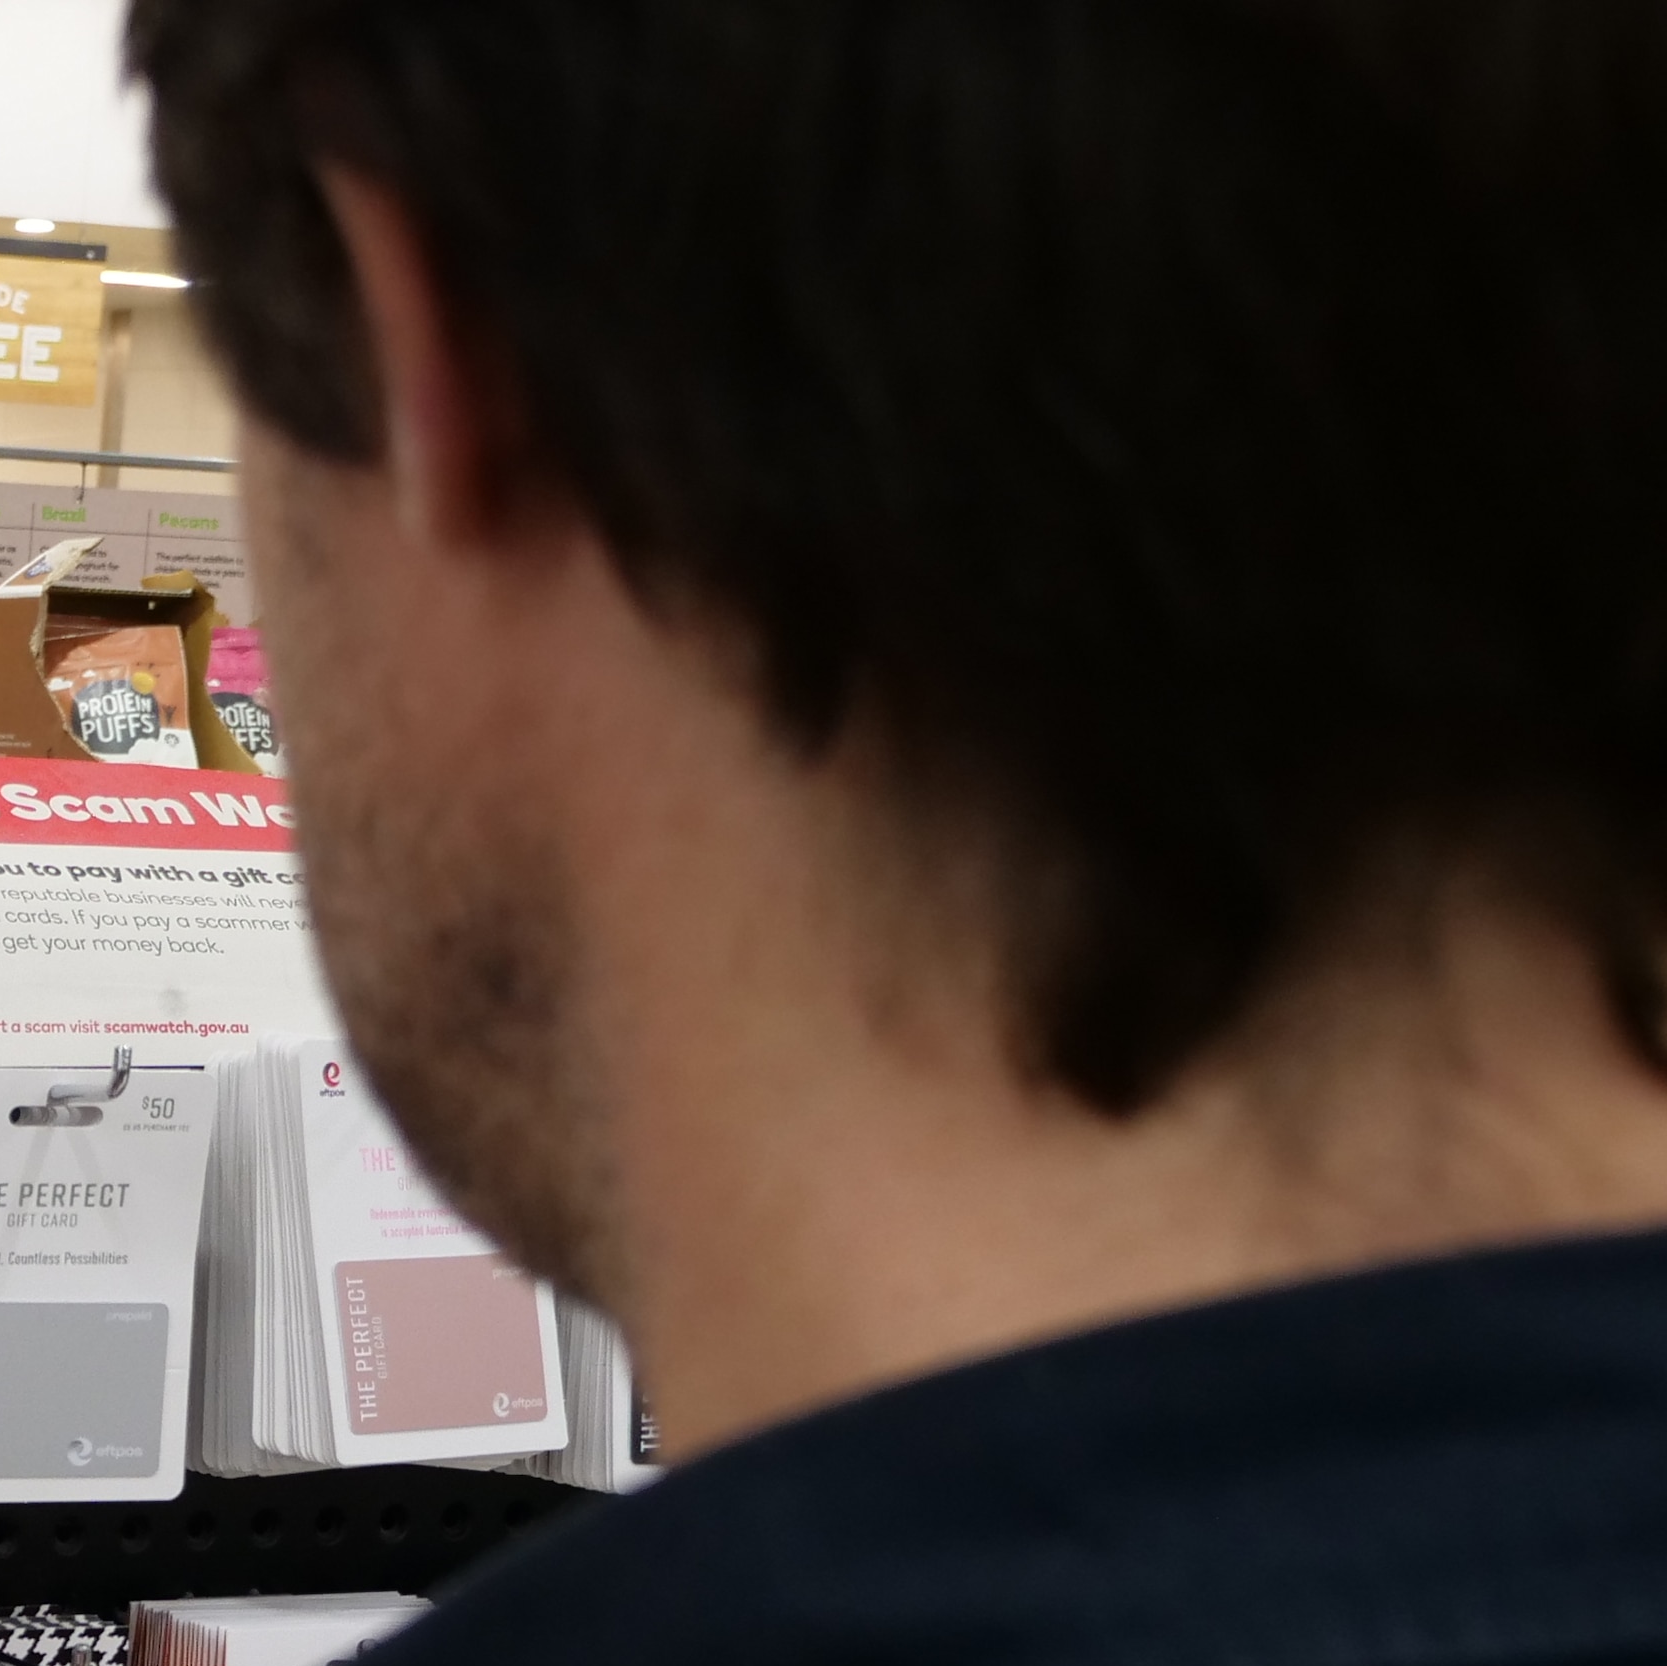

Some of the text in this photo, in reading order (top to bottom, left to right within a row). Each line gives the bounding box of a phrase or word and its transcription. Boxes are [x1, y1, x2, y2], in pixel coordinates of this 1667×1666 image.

[0, 783, 195, 826] Scam
[28, 862, 61, 877] to
[66, 865, 122, 883] pay
[126, 865, 193, 882] with
[199, 870, 218, 882] a
[223, 867, 269, 888] gift
[11, 1023, 21, 1033] a
[25, 1023, 65, 1033] scam
[70, 1020, 100, 1033] visit
[104, 1021, 249, 1037] scamwatch.gov.au
[142, 1096, 175, 1119] $50
[18, 1183, 130, 1207] PERFECT
[7, 1213, 78, 1228] GIFT CARD
[8, 1252, 60, 1265] Countless
[64, 1252, 128, 1265] Possibilities
